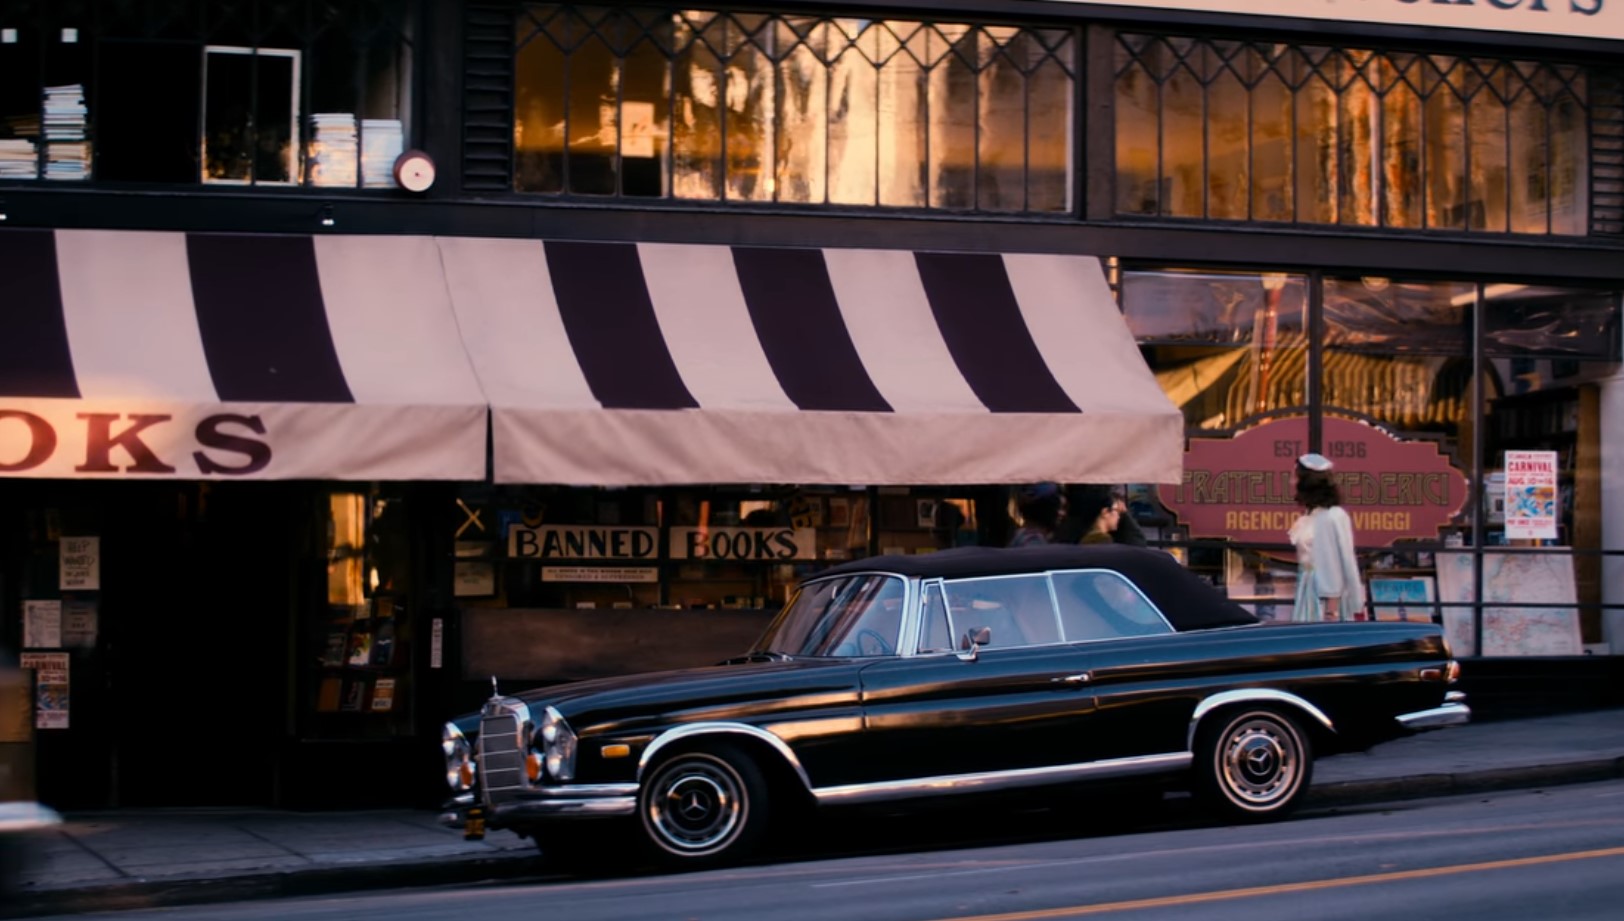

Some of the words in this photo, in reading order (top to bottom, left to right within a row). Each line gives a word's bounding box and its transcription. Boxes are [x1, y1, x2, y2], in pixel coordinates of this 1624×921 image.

[1274, 440, 1302, 457] EST
[1328, 441, 1366, 458] 1936
[1508, 461, 1552, 472] CARNIVAL
[1334, 471, 1450, 505] EDERICI
[1353, 511, 1410, 530] VIAGGI
[515, 529, 654, 558] BANNED
[686, 530, 798, 559] BOOKS
